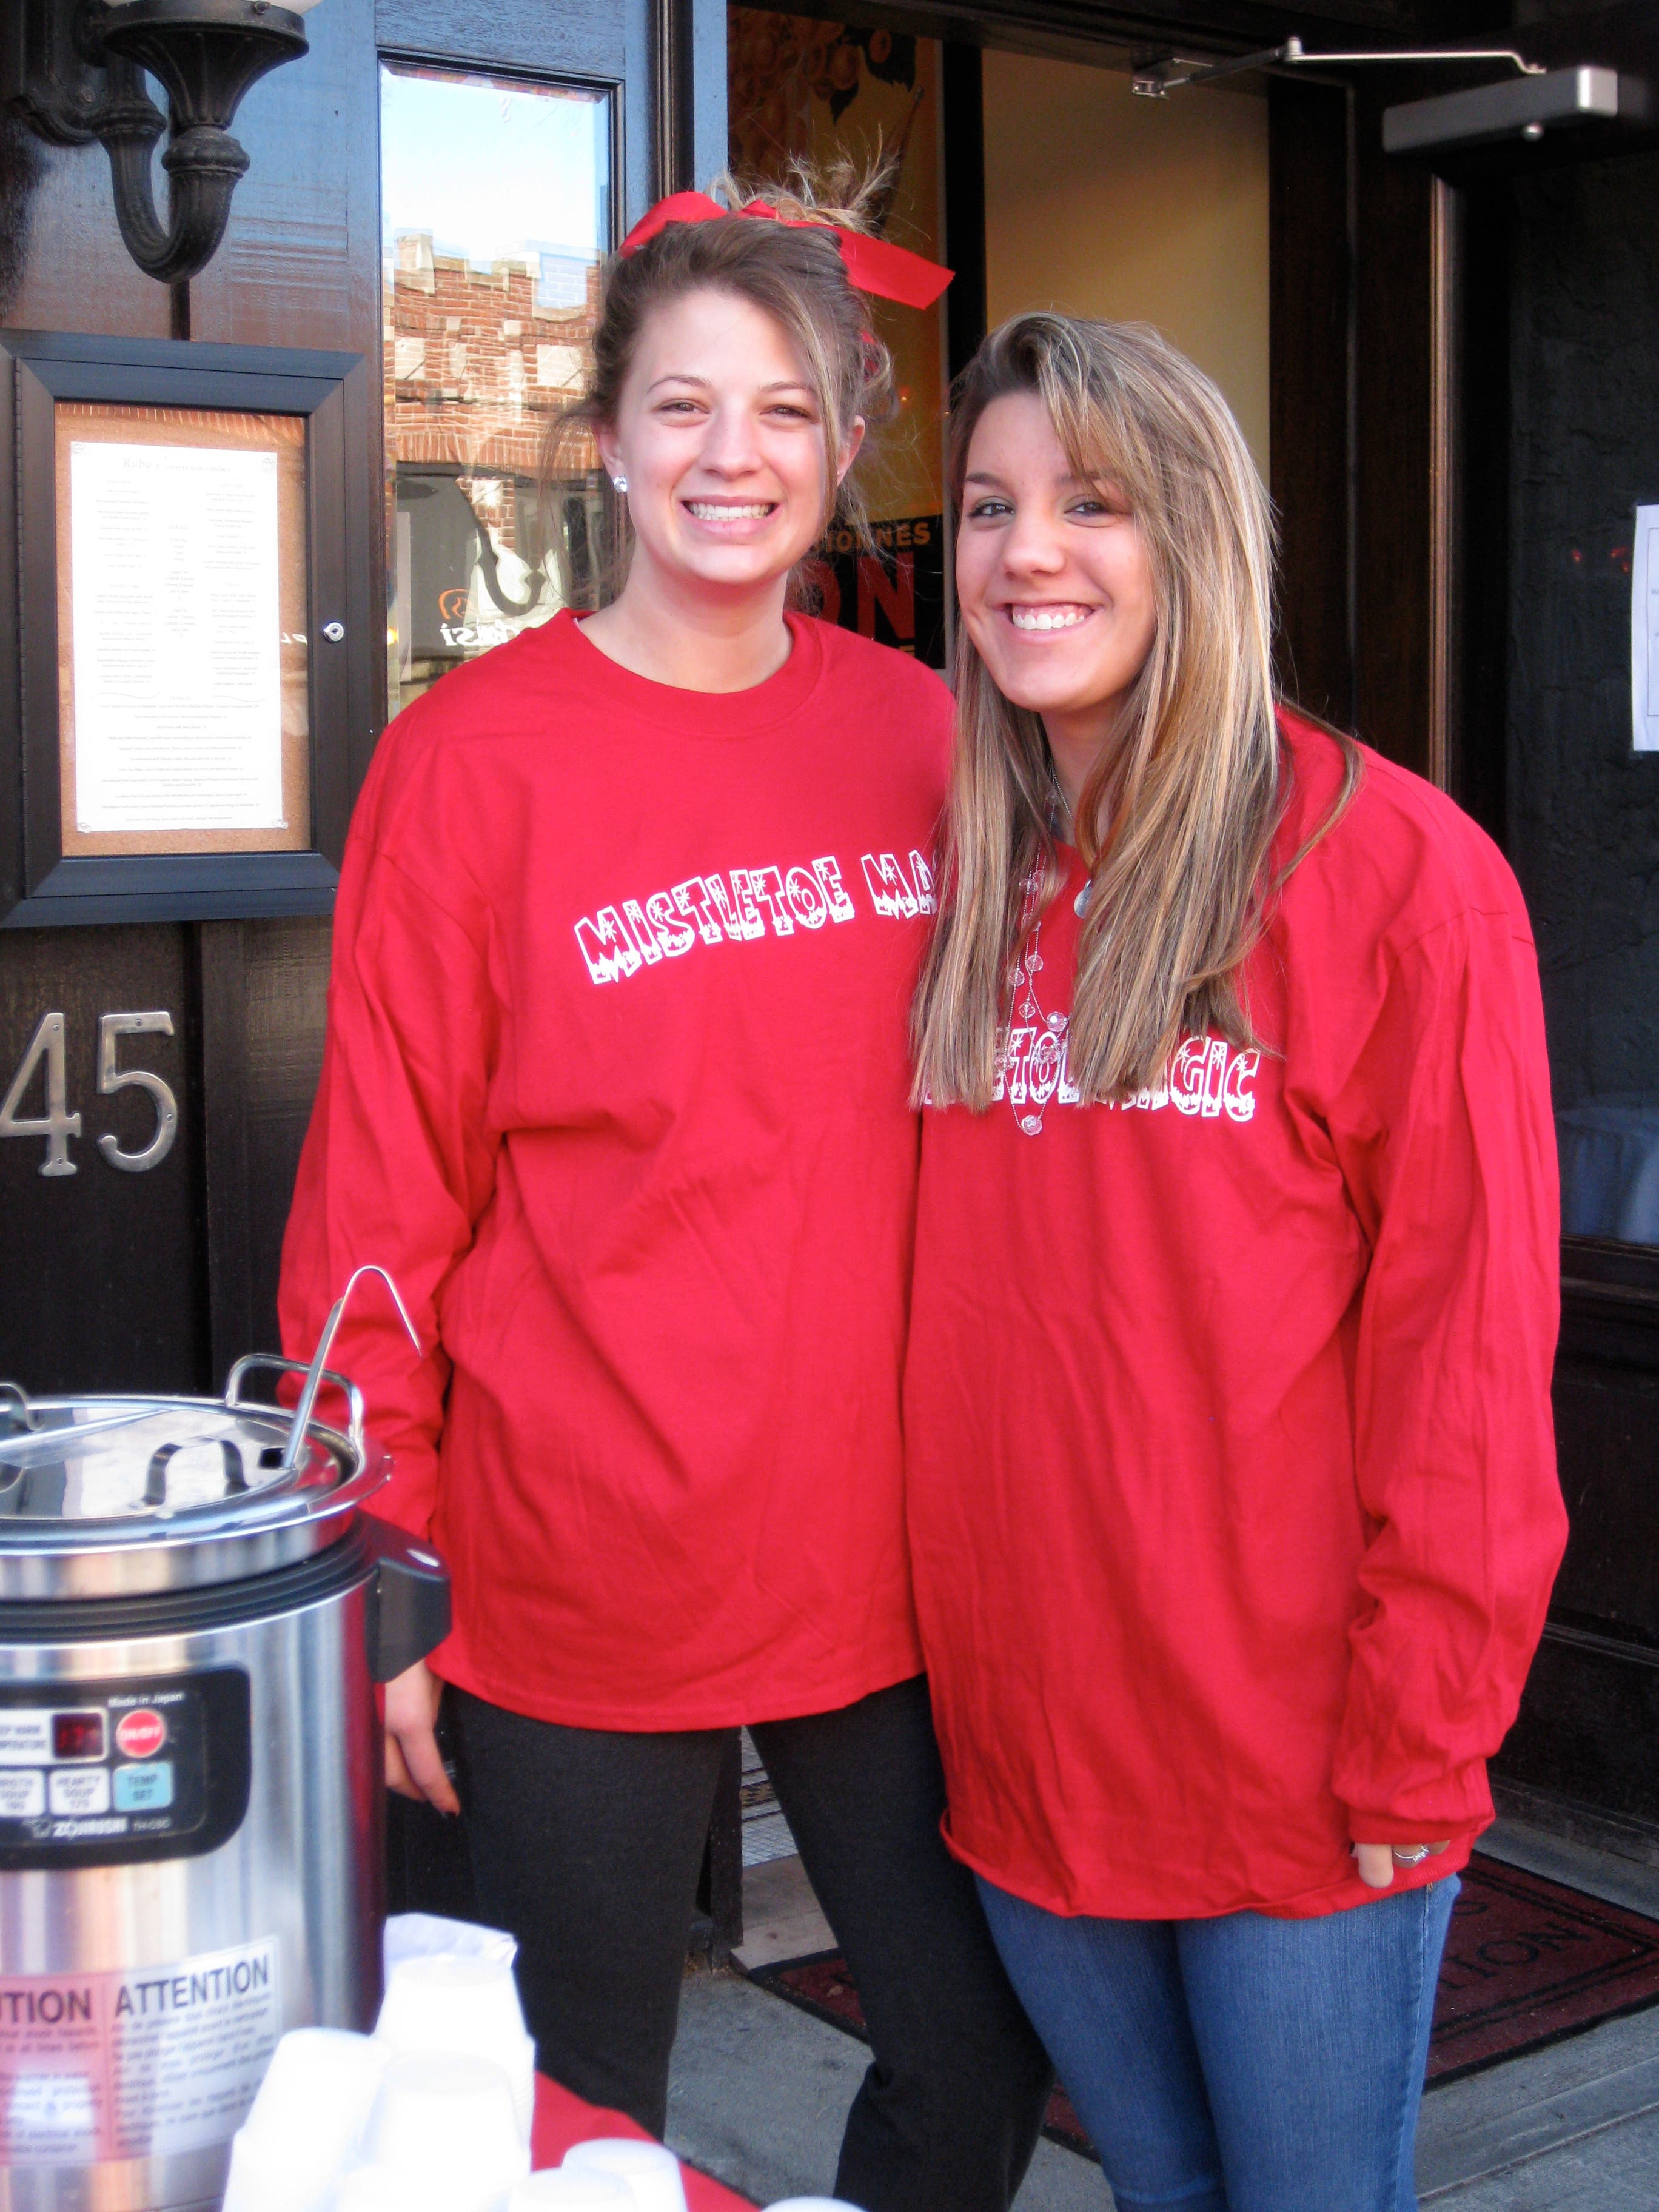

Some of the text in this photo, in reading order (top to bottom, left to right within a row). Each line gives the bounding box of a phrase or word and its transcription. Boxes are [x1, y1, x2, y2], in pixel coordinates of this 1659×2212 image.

[790, 550, 916, 640] ON
[574, 849, 938, 985] MISTLETOE MA
[0, 1011, 178, 1177] 45
[1121, 1035, 1261, 1123] GIC
[152, 1691, 184, 1704] Japan
[127, 1774, 158, 1787] TEMP
[132, 1789, 153, 1803] SET
[114, 1954, 269, 2018] ATTENTION
[1443, 1921, 1592, 1987] ION
[0, 1987, 92, 2024] TION
